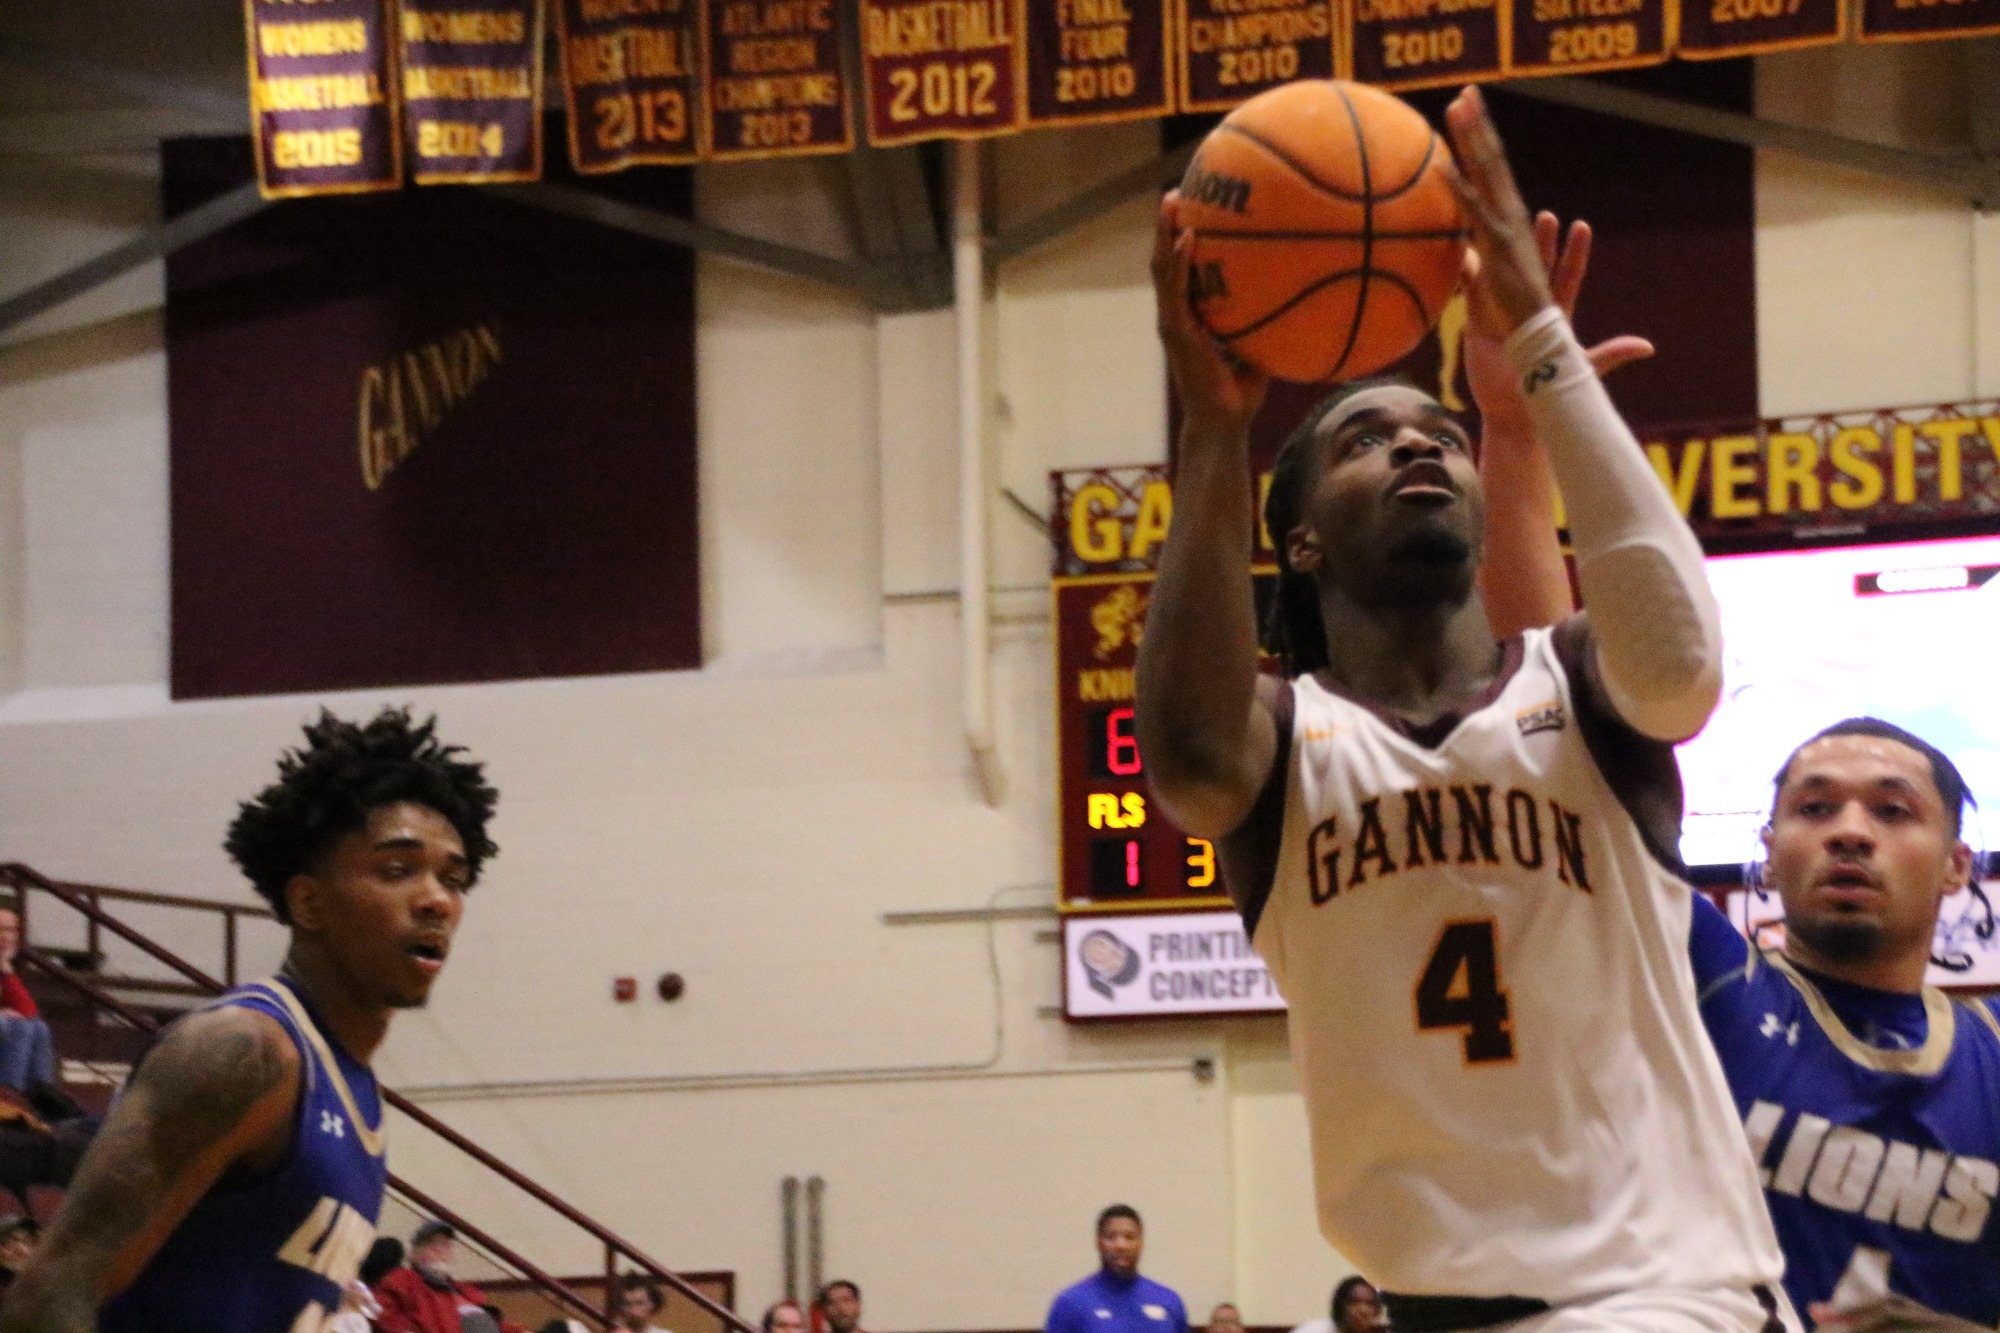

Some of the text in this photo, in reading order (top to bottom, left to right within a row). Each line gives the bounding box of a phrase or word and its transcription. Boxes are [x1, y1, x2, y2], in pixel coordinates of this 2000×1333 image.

[865, 0, 1011, 58] BASKETBALL
[1382, 25, 1464, 68] 2010
[1549, 21, 1638, 63] 2009
[1055, 63, 1136, 101] 2010
[1217, 46, 1299, 86] 2010
[888, 61, 997, 122] 2012
[273, 128, 362, 169] 2015
[1087, 792, 1146, 831] FLS
[1125, 840, 1140, 888] 1
[1306, 783, 1593, 907] GANNON
[1148, 967, 1274, 1002] CONCEPT
[1412, 914, 1518, 1068] 4
